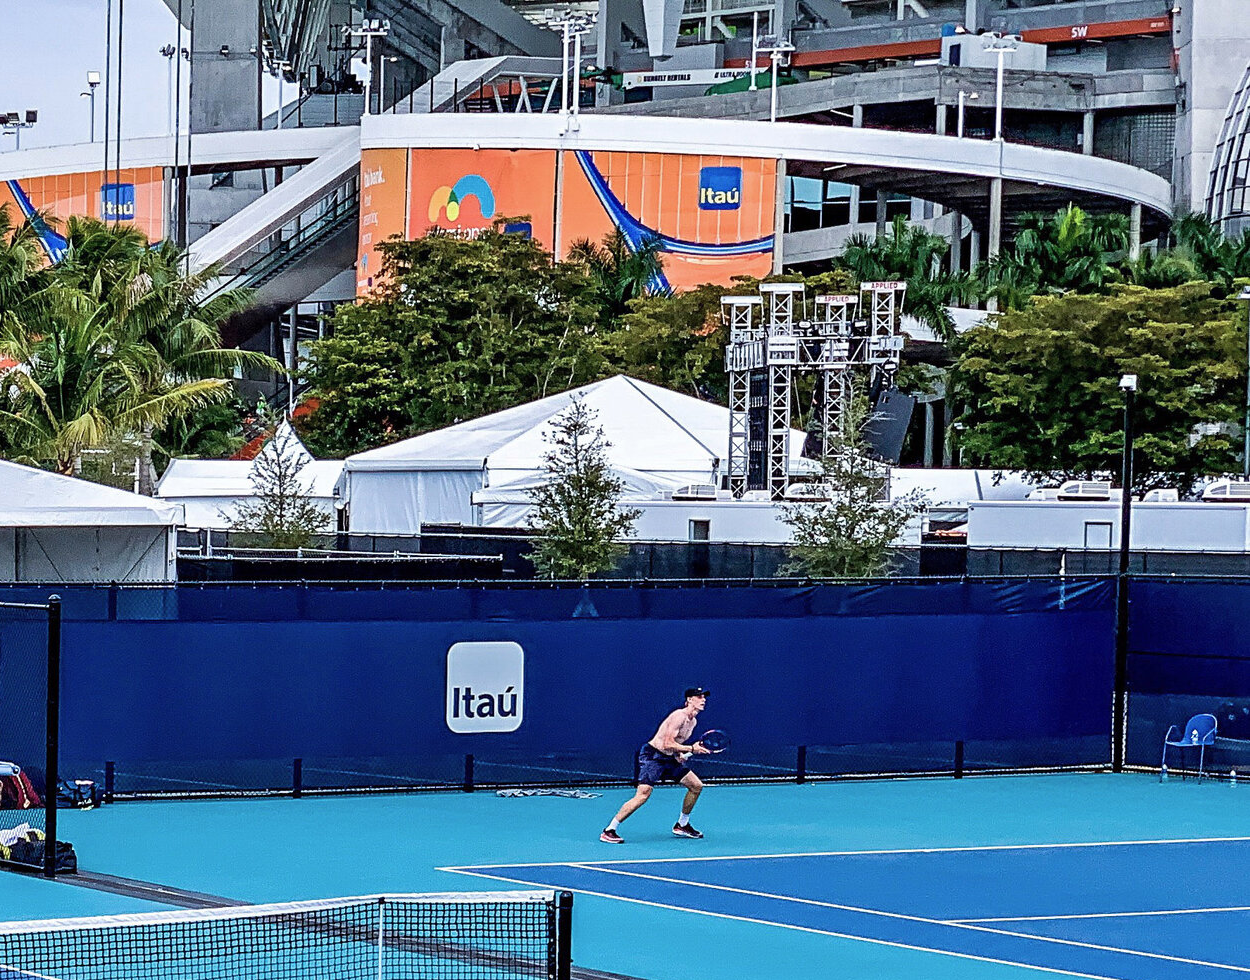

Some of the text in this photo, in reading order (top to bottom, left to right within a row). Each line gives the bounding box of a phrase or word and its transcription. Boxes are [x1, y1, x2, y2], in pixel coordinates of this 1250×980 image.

[1071, 25, 1088, 38] SW
[667, 74, 691, 82] RENTALS
[700, 187, 739, 204] Itaú
[102, 201, 134, 215] Itaú
[871, 282, 898, 290] APPLIED
[453, 686, 517, 718] Itaú
